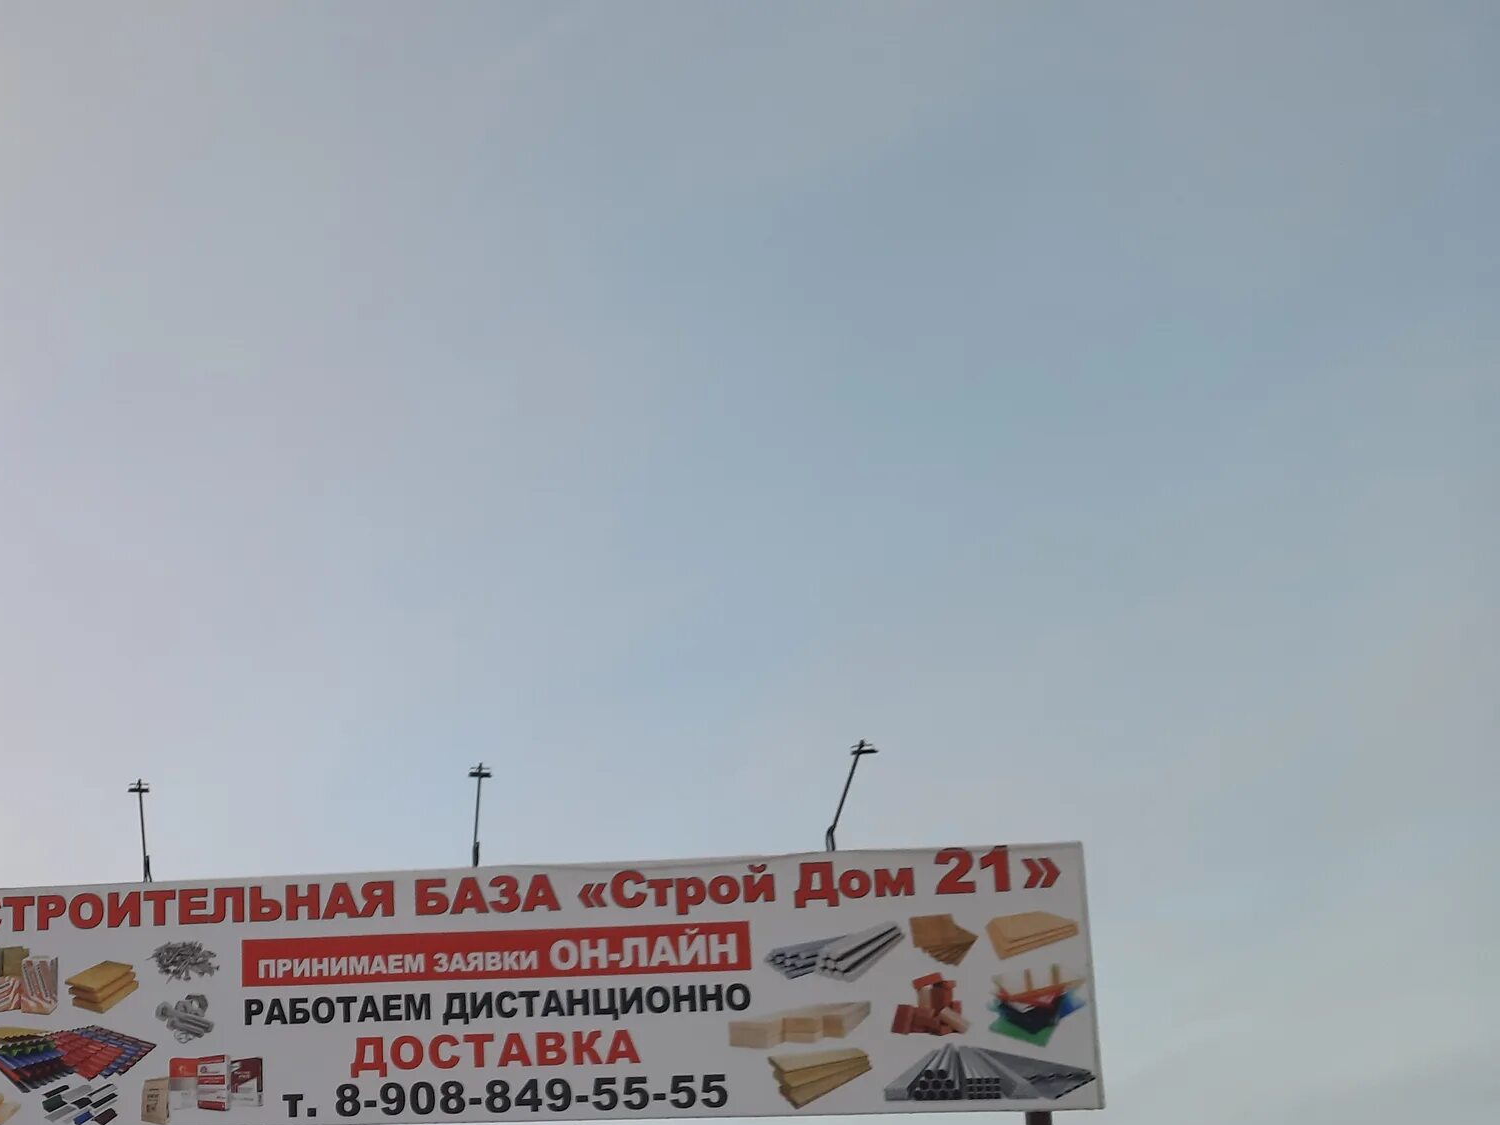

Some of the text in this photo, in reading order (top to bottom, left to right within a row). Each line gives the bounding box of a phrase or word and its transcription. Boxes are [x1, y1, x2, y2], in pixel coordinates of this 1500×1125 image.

[414, 872, 560, 916] БАЗА
[577, 864, 776, 915] «Строй
[794, 861, 916, 908] Дом
[934, 845, 1061, 896] 21»
[257, 927, 739, 979] ПРИНИМАЕМ ЗАЯВКИ ОН-ЛАЙН
[243, 982, 752, 1026] РАБОТАЕМ ДИСТАНЦИОННО
[351, 1029, 641, 1078] ДОСТАВКА
[282, 1074, 729, 1118] т. 8-908-849-55-55
